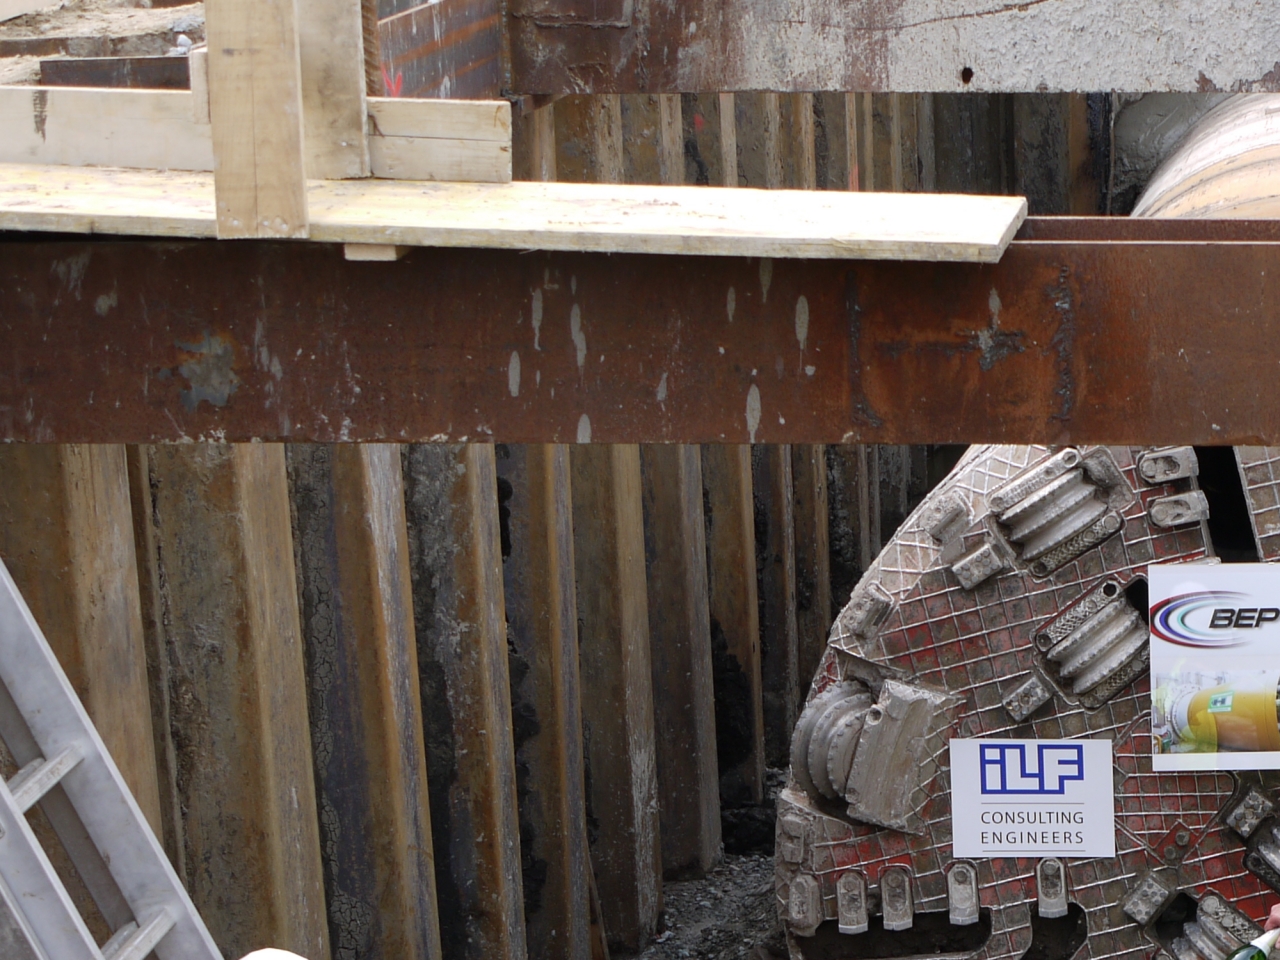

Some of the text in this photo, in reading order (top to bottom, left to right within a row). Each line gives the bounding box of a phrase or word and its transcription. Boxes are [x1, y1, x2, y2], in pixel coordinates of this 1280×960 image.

[1209, 608, 1280, 629] BEP
[981, 811, 1084, 824] CONSULTING
[981, 831, 1084, 844] ENGINEERS
